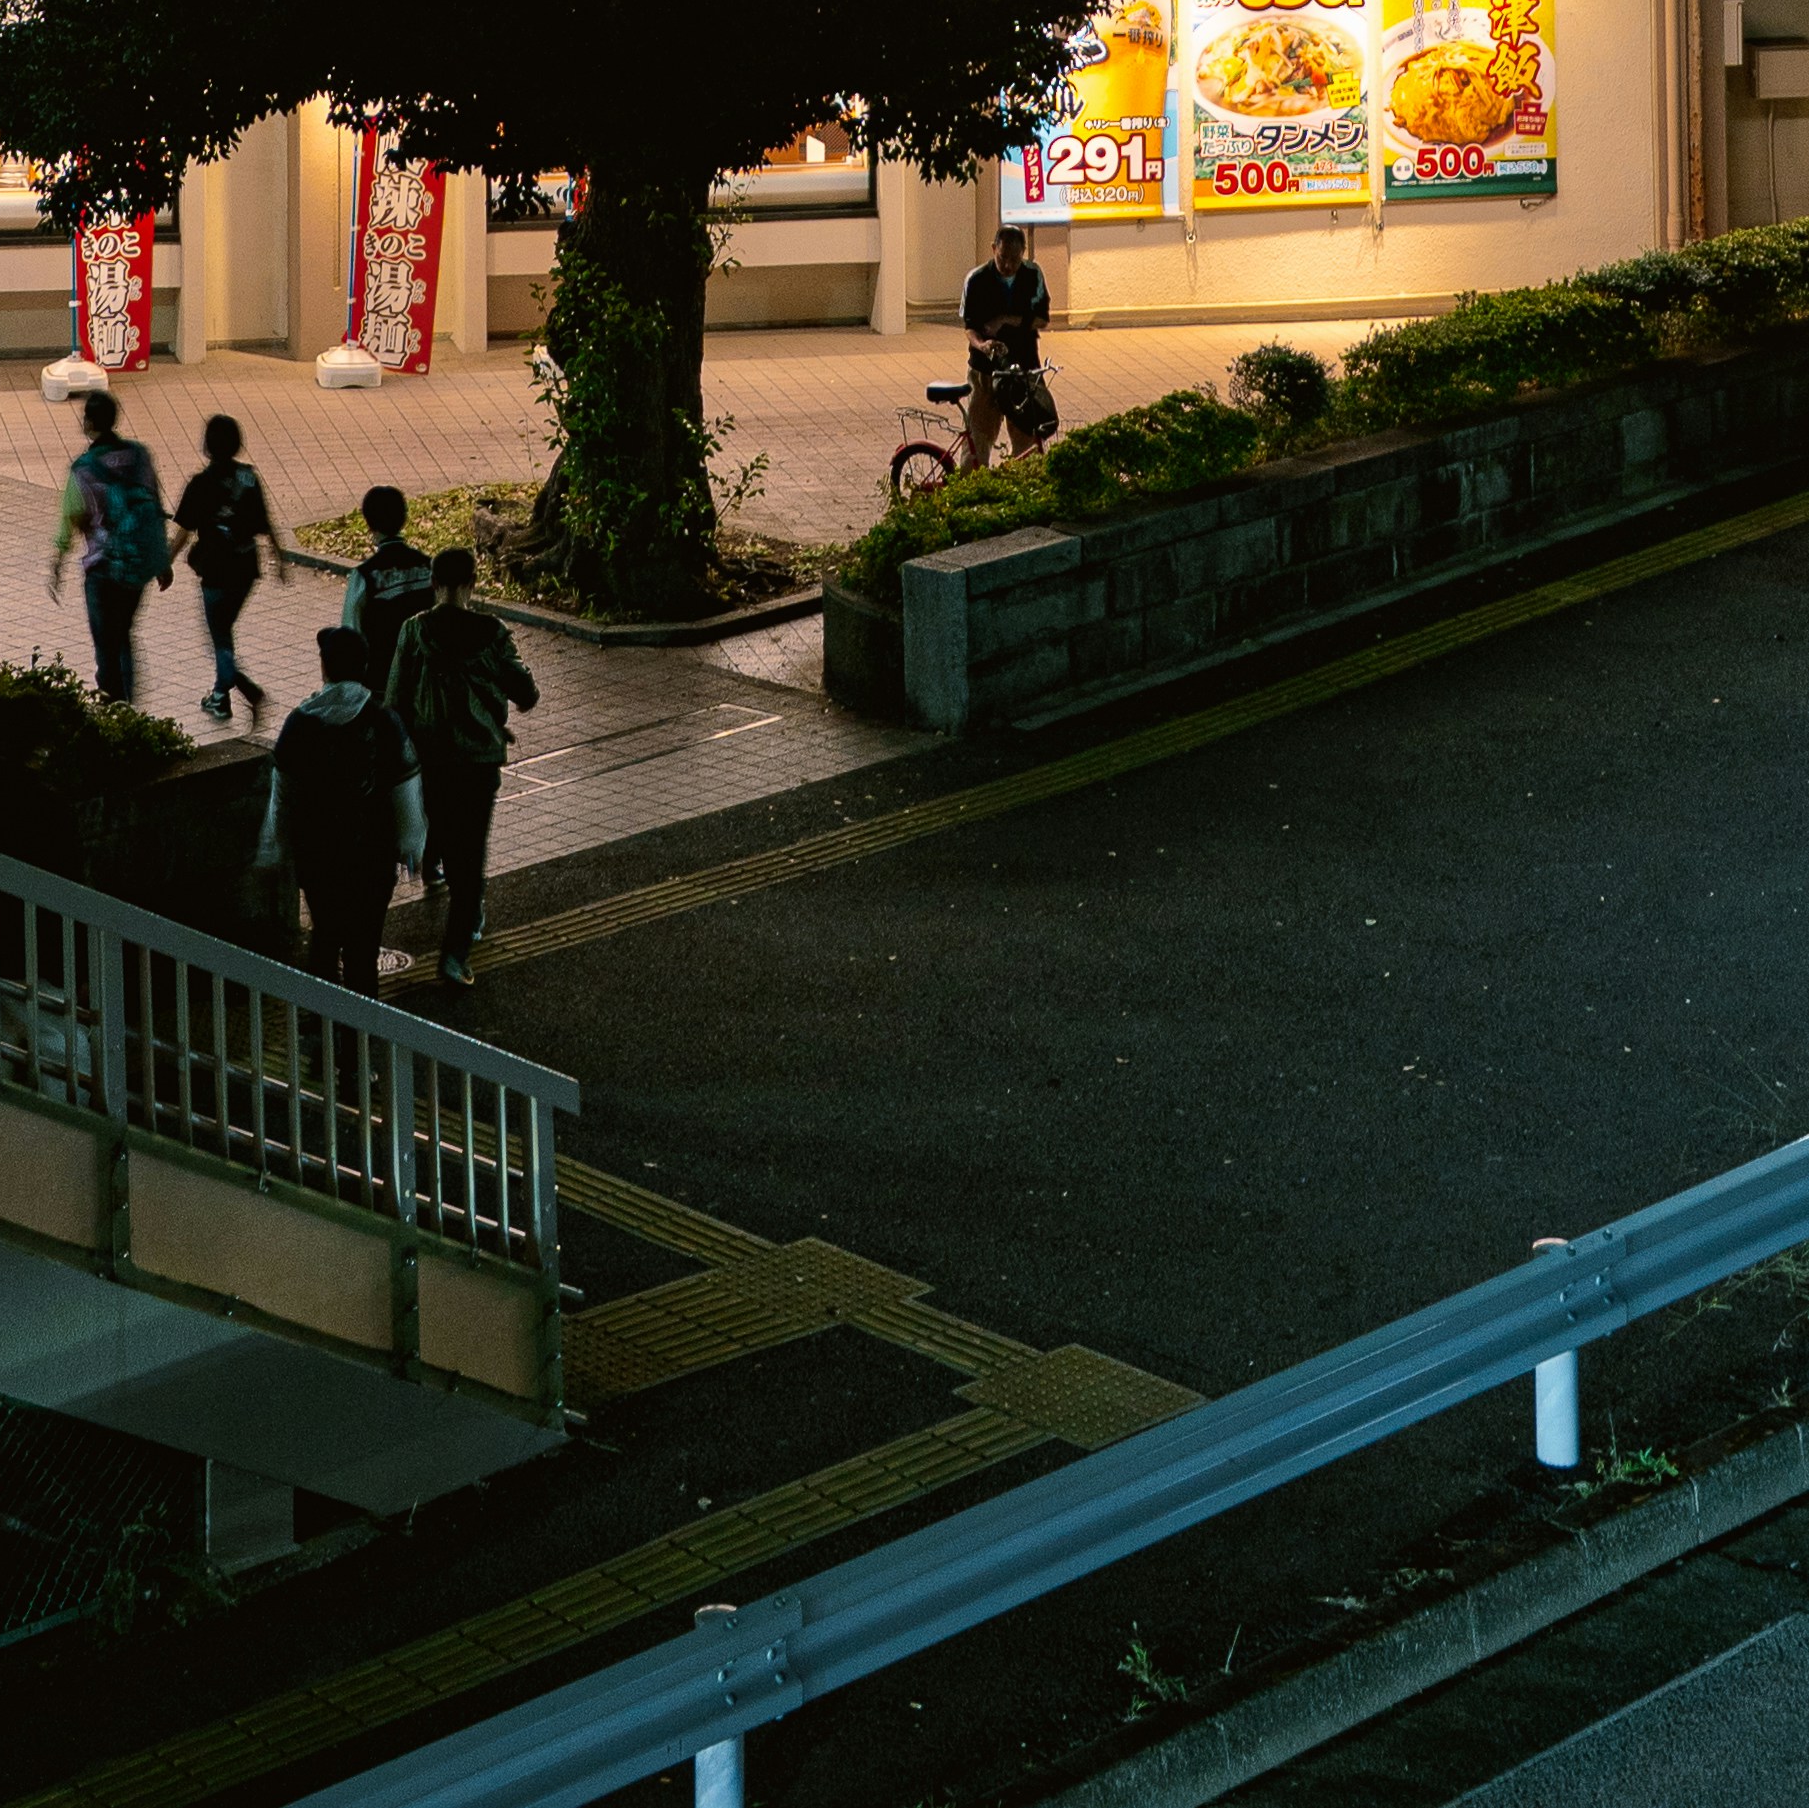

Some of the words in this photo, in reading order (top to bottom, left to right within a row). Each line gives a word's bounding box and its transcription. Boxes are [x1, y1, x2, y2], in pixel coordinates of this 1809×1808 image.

[1202, 124, 1230, 139] 野菜
[1256, 123, 1363, 152] タンメン
[1047, 133, 1164, 183] 291円
[1202, 140, 1253, 155] たっぷり
[1415, 144, 1495, 178] 500円
[1024, 144, 1041, 199] ジョッキ
[1214, 161, 1299, 196] 500円
[1059, 185, 1145, 204] (税込320円)
[82, 232, 141, 262] きのこ
[364, 235, 427, 260] きのこ
